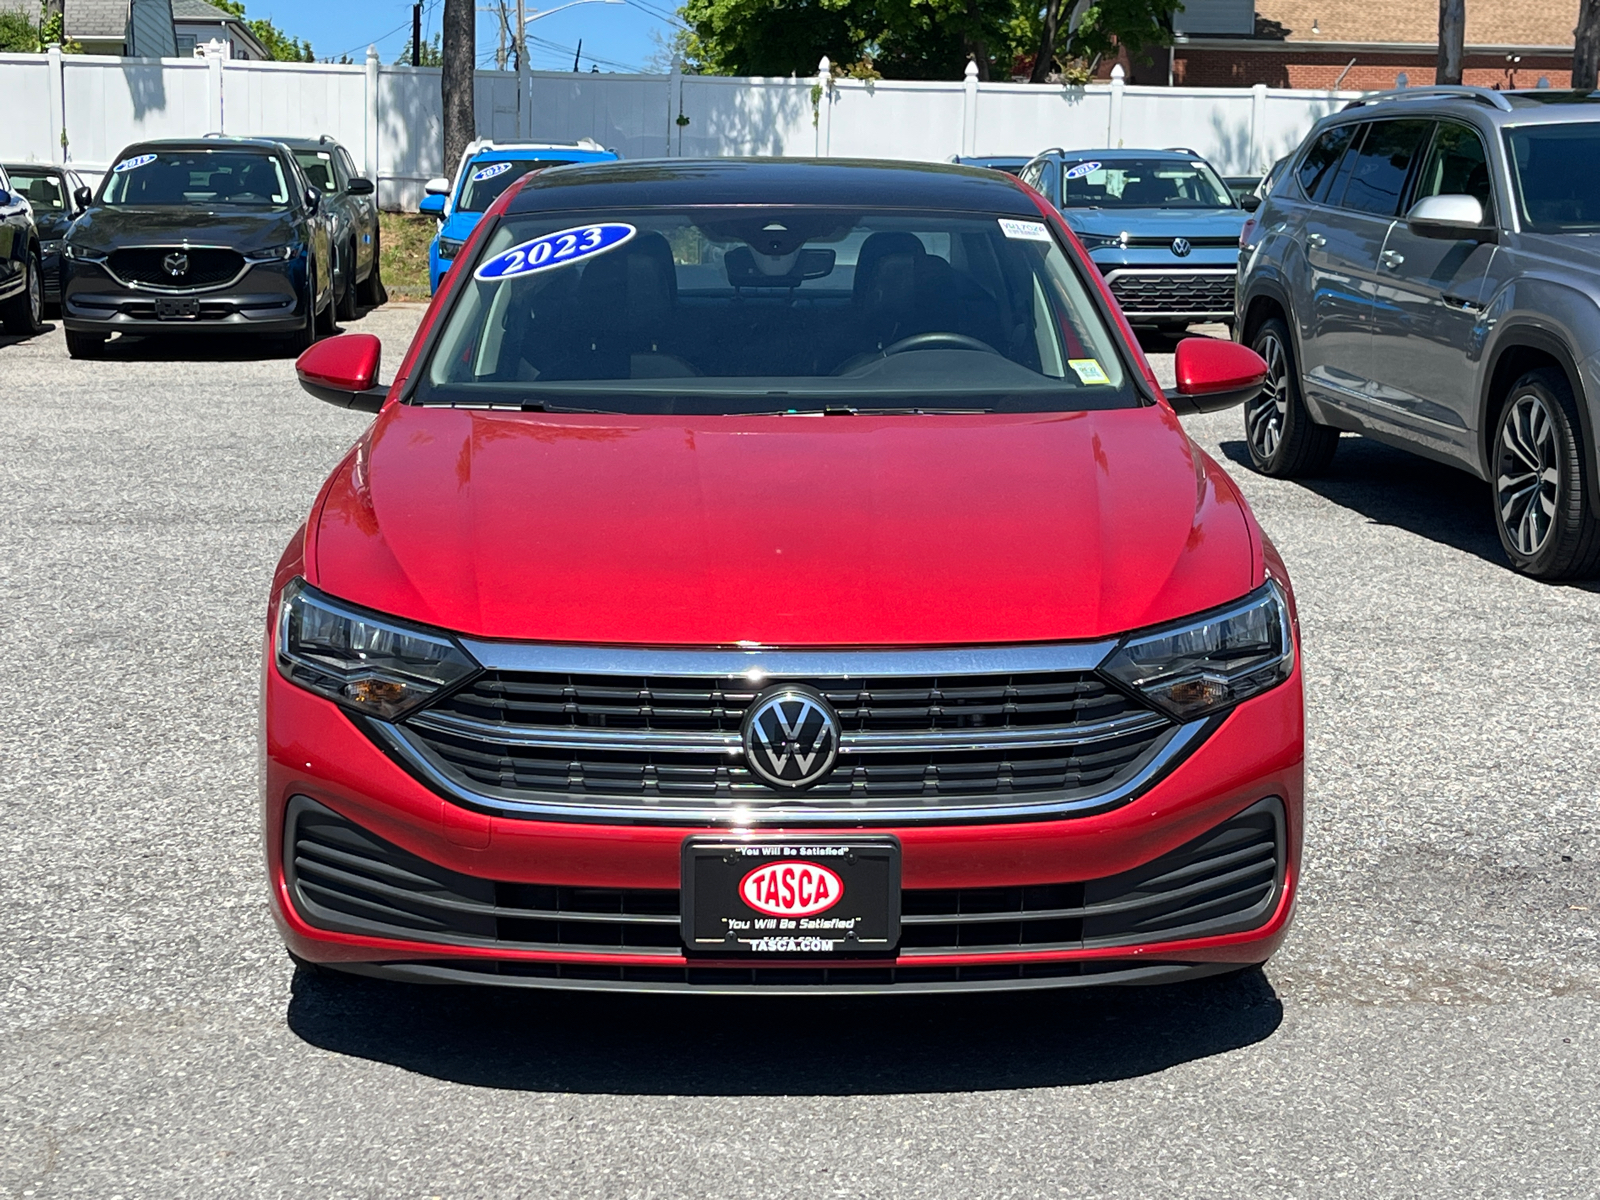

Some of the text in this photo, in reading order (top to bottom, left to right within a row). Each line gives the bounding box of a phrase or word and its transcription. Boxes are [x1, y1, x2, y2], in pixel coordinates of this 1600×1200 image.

[501, 227, 602, 275] 2023
[762, 847, 781, 856] Will
[783, 847, 797, 856] Be
[751, 867, 830, 909] TASCA
[754, 918, 777, 929] Will
[779, 919, 796, 929] Be
[750, 939, 833, 951] TASCA.COM
